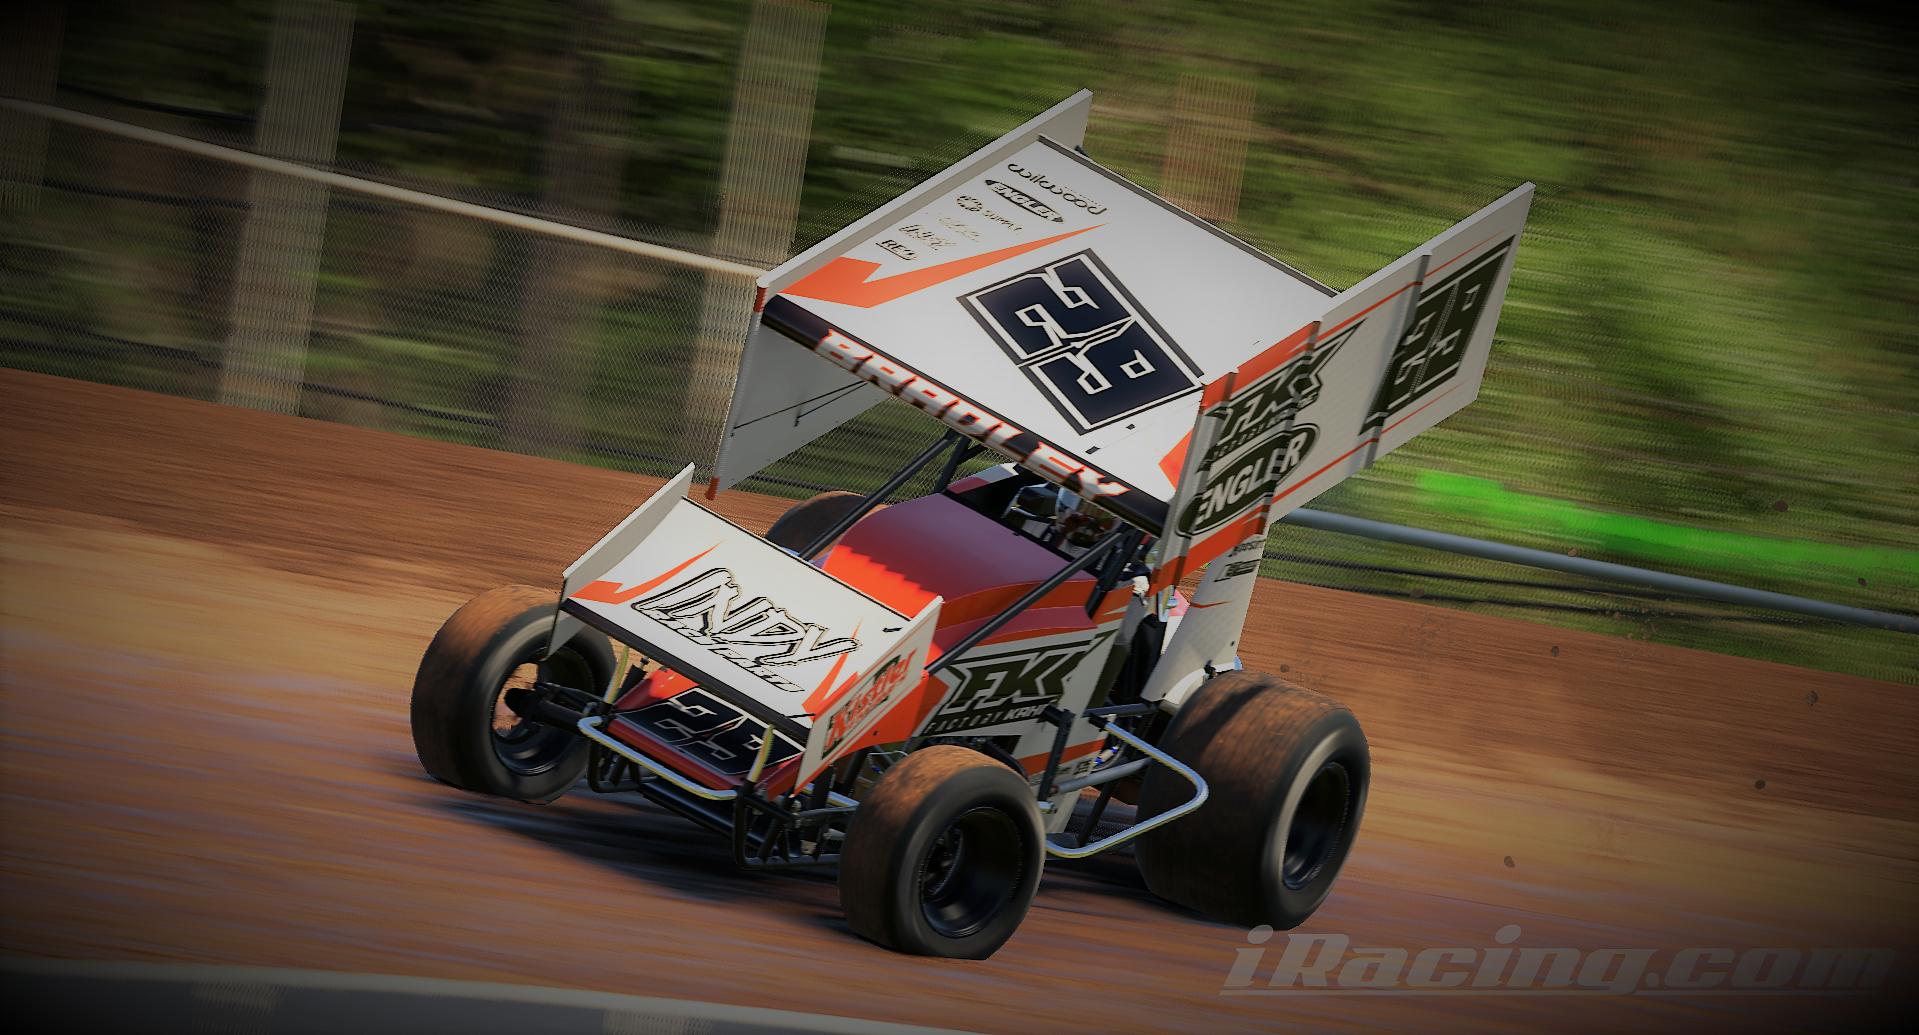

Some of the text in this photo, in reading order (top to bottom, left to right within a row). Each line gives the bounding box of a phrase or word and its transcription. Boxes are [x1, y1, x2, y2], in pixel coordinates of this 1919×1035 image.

[1006, 162, 1108, 216] wilwood
[964, 250, 1204, 434] 29
[1366, 238, 1514, 432] 29
[815, 328, 1131, 499] BRADLEY
[1195, 431, 1308, 526] ENGLER
[631, 567, 862, 667] INDY
[934, 628, 1102, 716] FK
[1003, 702, 1053, 721] KAH
